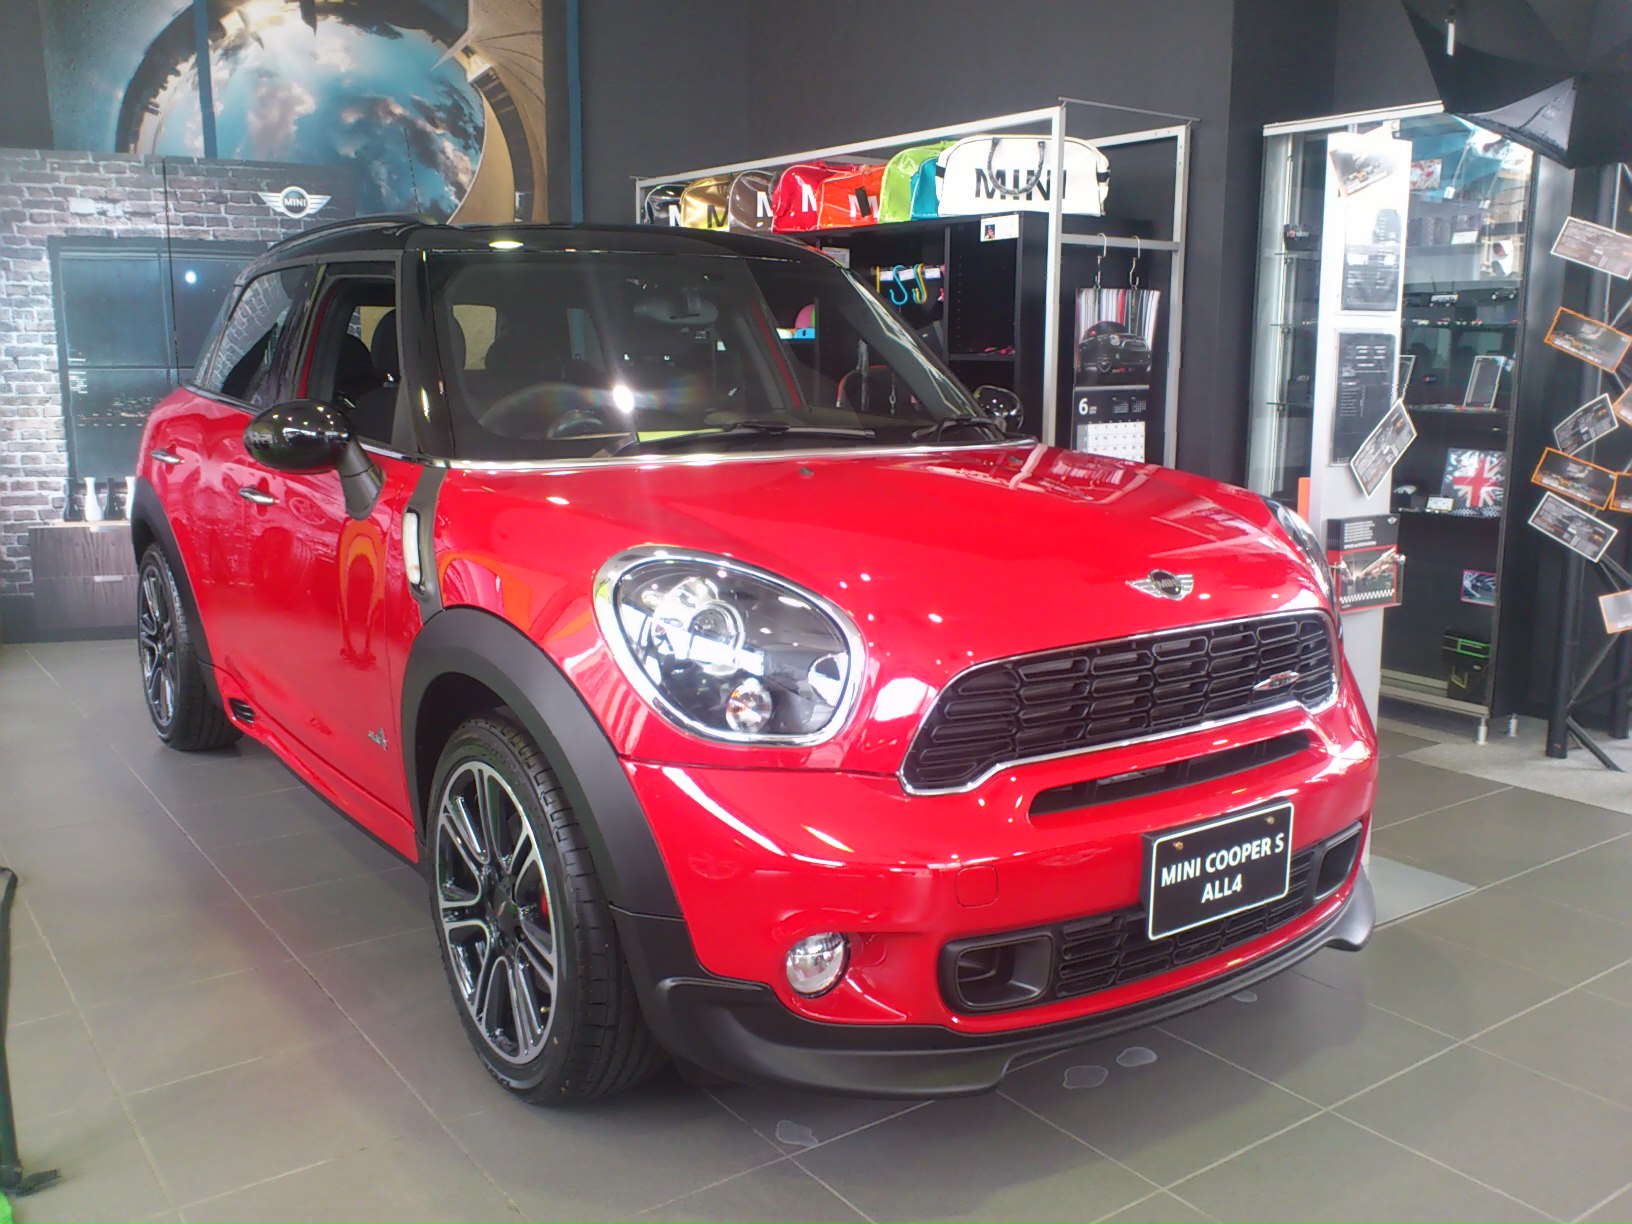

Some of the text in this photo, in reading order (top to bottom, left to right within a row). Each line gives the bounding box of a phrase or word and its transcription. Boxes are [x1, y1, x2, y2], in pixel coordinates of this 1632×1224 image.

[975, 168, 1067, 201] MINI
[284, 198, 307, 207] MINI
[1079, 398, 1088, 415] 6
[1161, 832, 1285, 887] MINI COOPER S
[1201, 874, 1242, 903] ALL4
